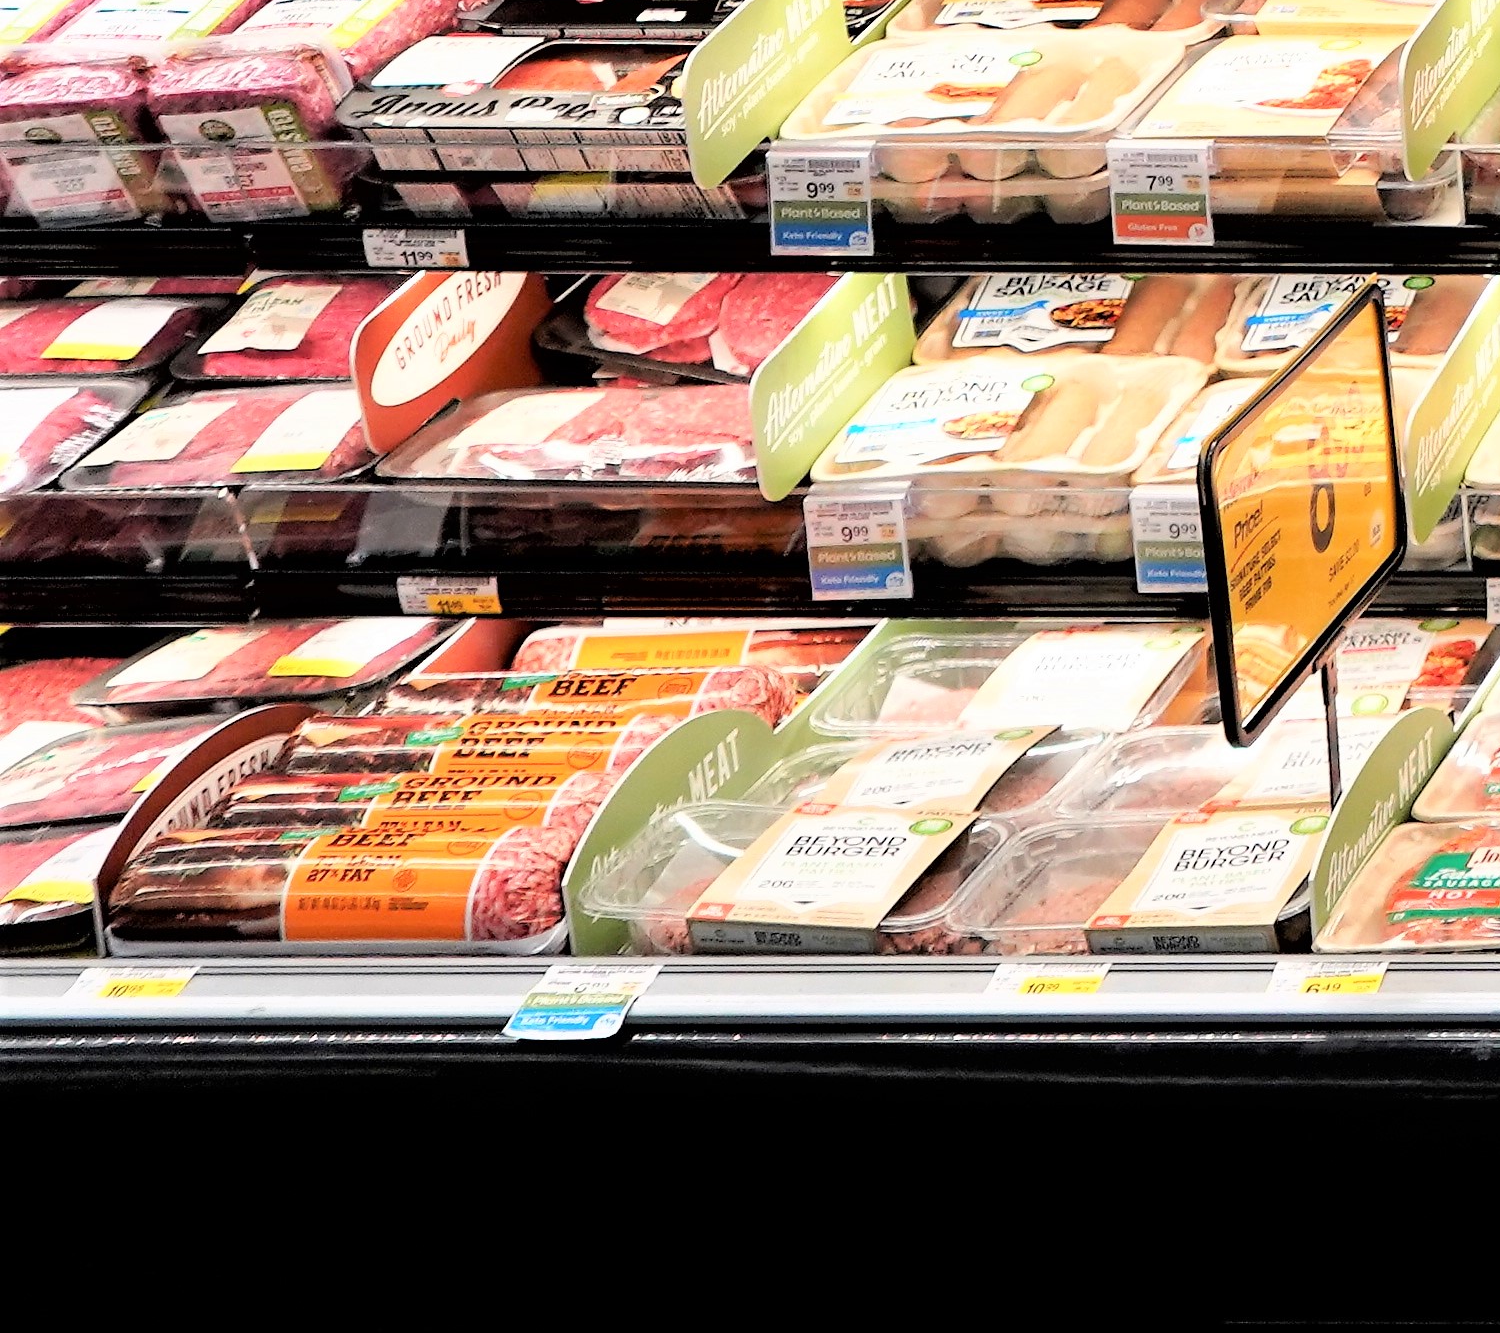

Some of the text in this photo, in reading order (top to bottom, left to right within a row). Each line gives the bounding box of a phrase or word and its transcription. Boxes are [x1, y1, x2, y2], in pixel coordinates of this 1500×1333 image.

[852, 273, 897, 348] MEAT
[395, 299, 453, 371] GROUND
[548, 676, 635, 697] BEEF
[688, 728, 740, 805] MEAT
[1398, 726, 1434, 807] MEAT
[404, 775, 557, 790] GROUND
[388, 790, 482, 811] BEEF
[794, 835, 907, 847] BEYOND
[1180, 839, 1290, 861] BEYOND
[786, 846, 901, 858] BURGER
[1174, 851, 1286, 872] BURGER
[342, 868, 376, 883] FAT
[1428, 889, 1477, 901] HOT
